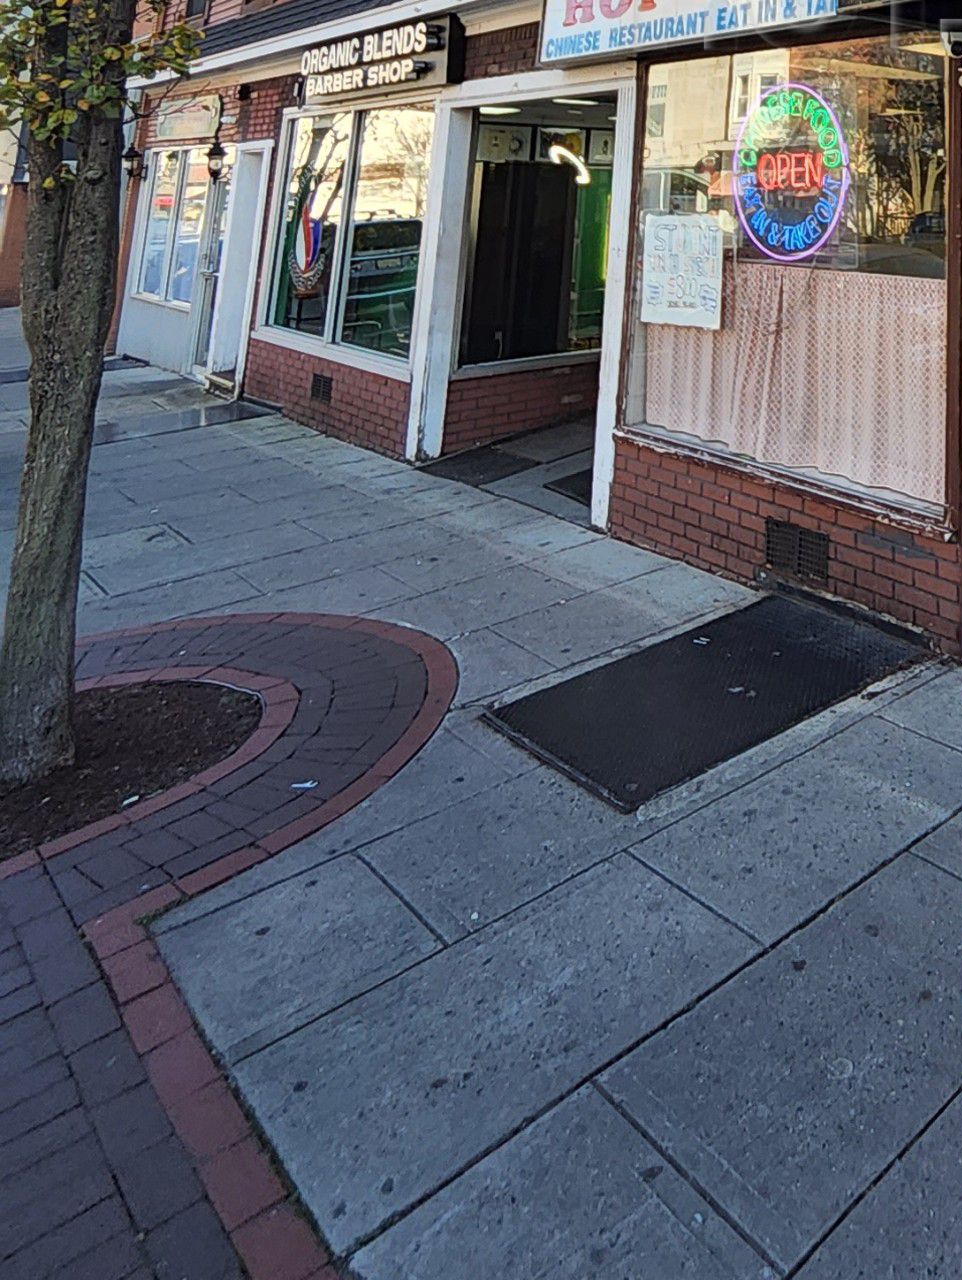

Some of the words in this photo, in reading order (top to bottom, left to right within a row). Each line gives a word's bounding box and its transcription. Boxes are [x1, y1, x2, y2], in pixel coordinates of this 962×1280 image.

[300, 37, 360, 76] ORGANIC
[362, 21, 427, 63] BLENDS
[545, 30, 601, 60] CHINESE
[608, 10, 709, 49] RESTAURANT
[716, 2, 751, 31] EAT
[305, 68, 364, 97] BARBER
[366, 58, 414, 87] SHOP
[802, 98, 843, 168] FOOD
[739, 172, 763, 209] EAT
[757, 152, 823, 191] OPEN
[814, 174, 842, 223] OUT
[750, 210, 772, 237] IN
[767, 224, 781, 247] &
[779, 214, 822, 251] TAKE
